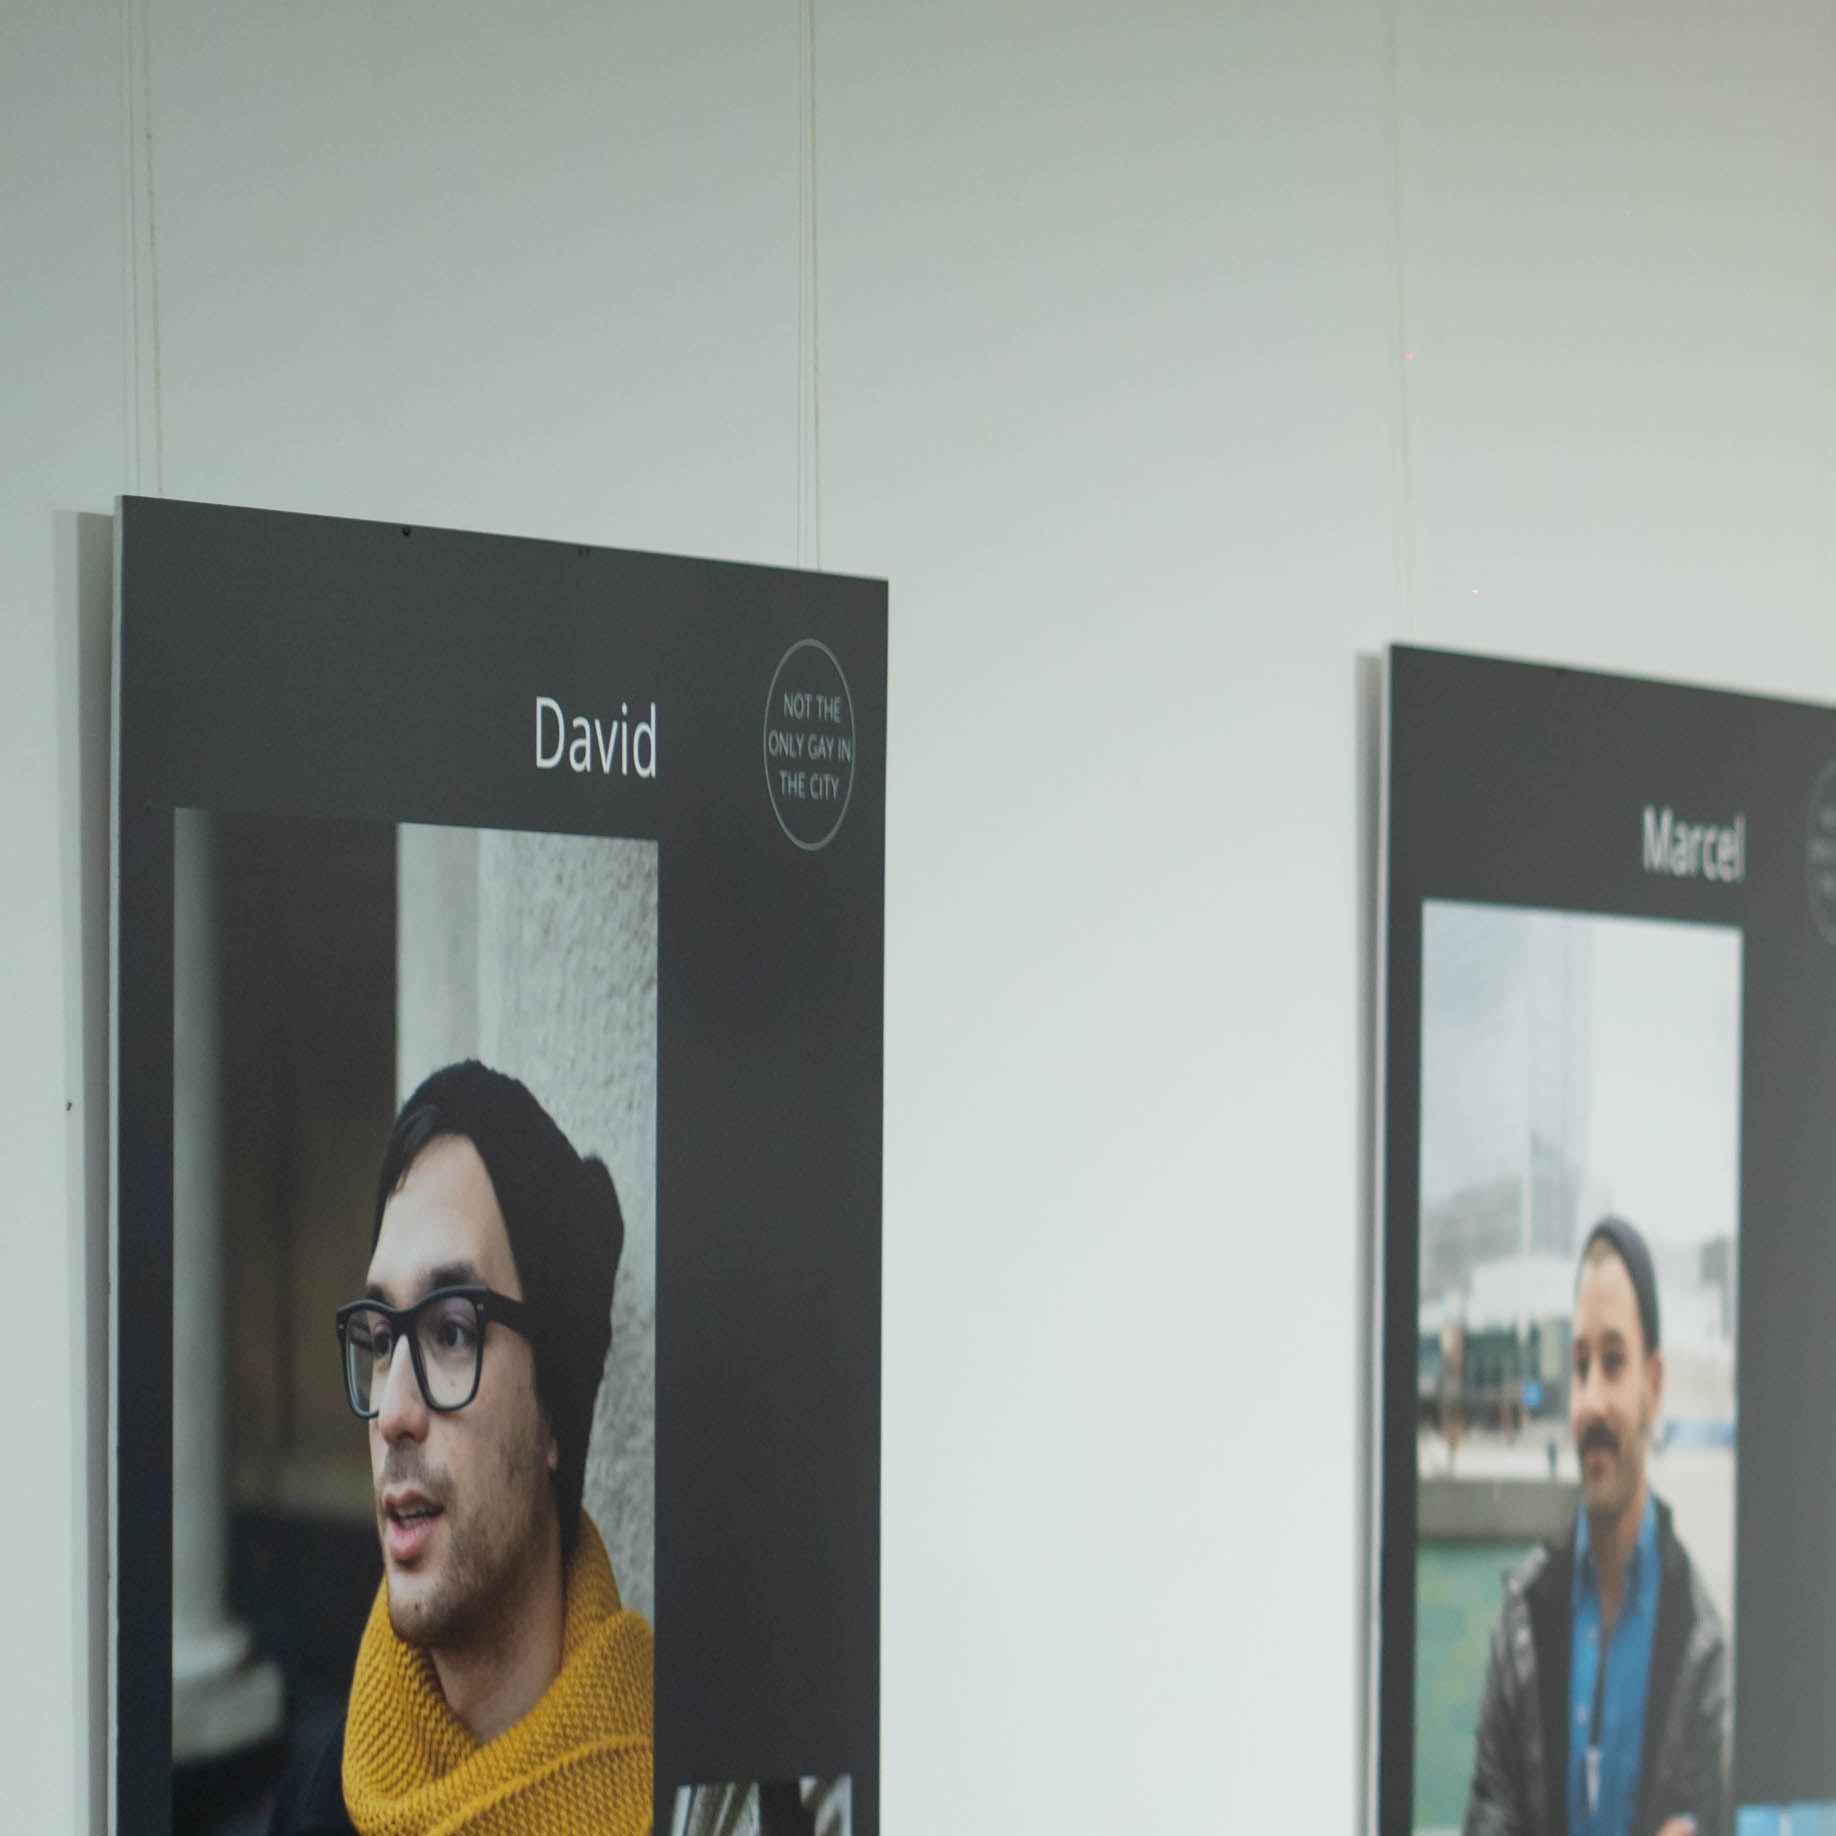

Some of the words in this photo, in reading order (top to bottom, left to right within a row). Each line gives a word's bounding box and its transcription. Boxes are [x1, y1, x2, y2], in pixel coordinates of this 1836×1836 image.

[784, 693, 812, 719] NOT
[816, 695, 841, 723] THE
[535, 695, 656, 778] David
[769, 730, 805, 758] ONLY
[808, 734, 834, 760] GAY
[838, 736, 851, 762] IN
[780, 770, 804, 799] THE
[810, 773, 840, 800] CITY
[1642, 804, 1746, 883] Marcel
